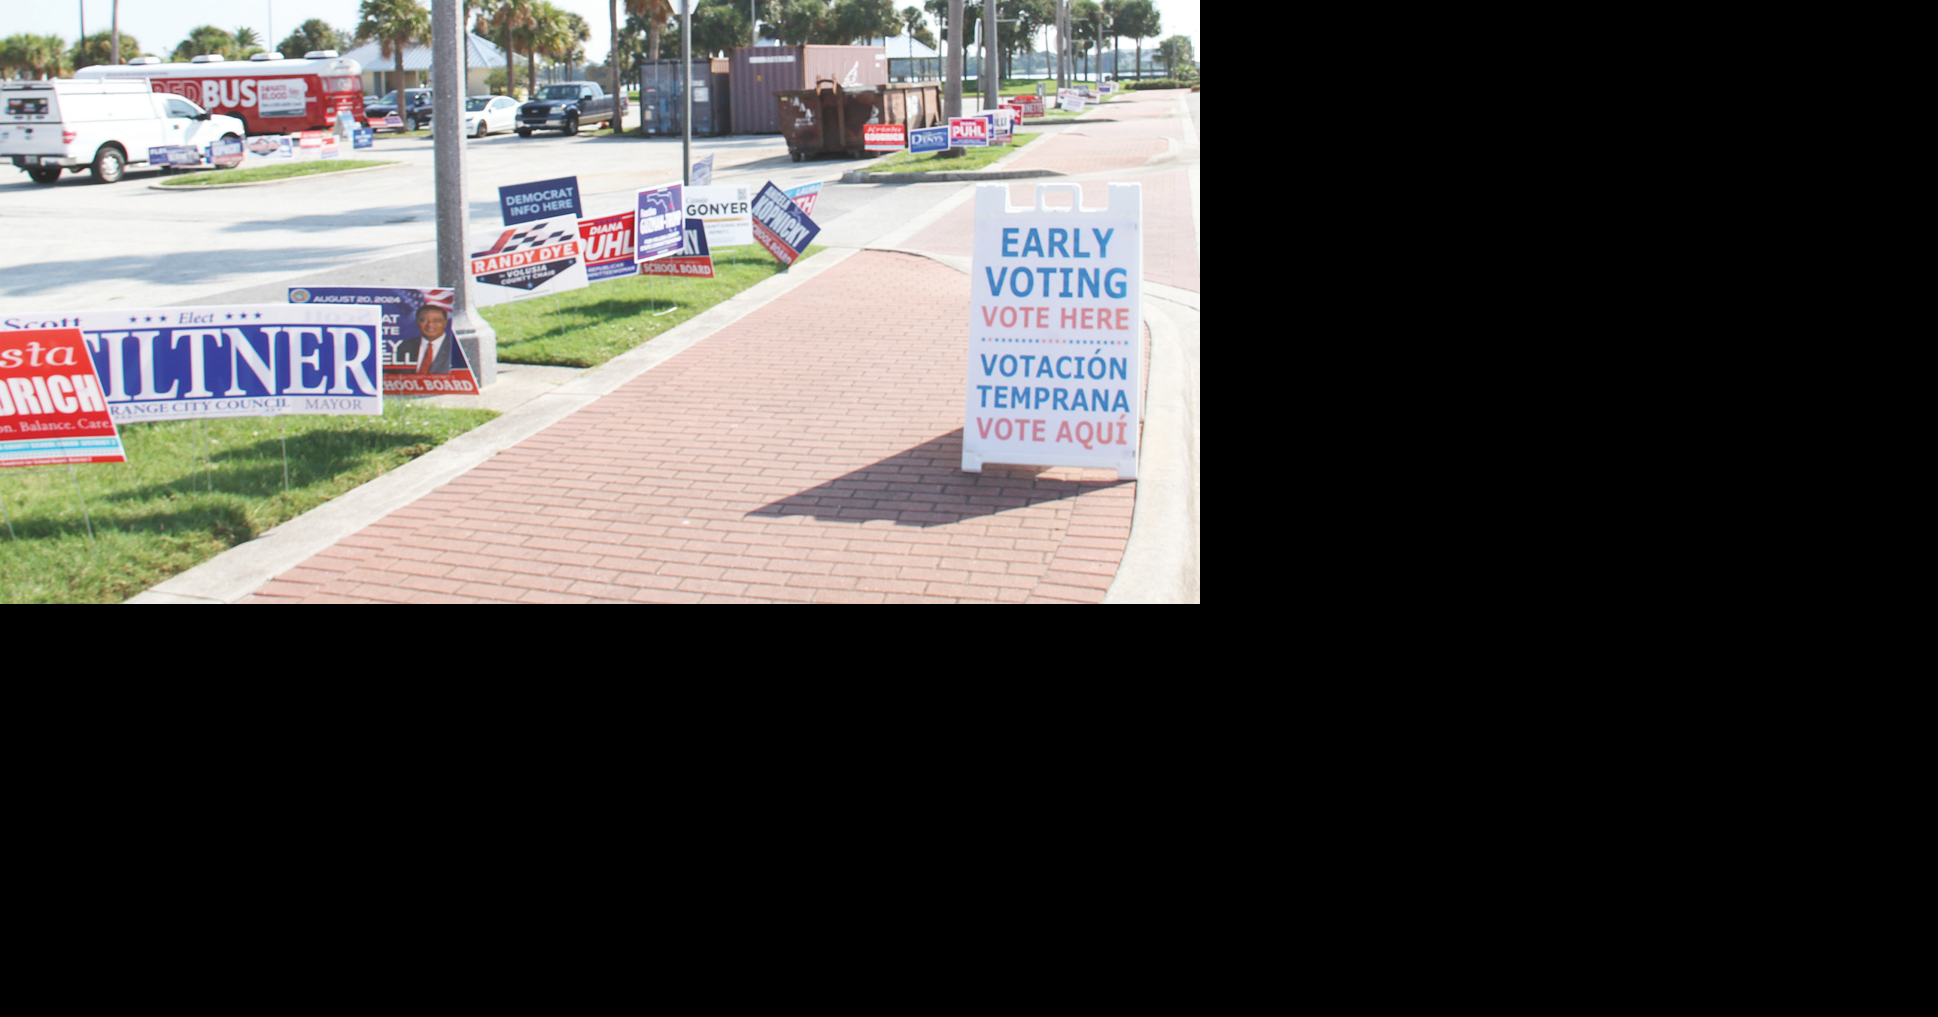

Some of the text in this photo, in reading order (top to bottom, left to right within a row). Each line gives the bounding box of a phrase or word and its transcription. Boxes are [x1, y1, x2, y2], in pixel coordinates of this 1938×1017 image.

[202, 79, 258, 108] BUS
[261, 92, 288, 101] BLOOD
[952, 125, 985, 137] PUHL
[505, 187, 574, 206] DEMOCRAT
[764, 186, 792, 211] ANGELA
[510, 198, 573, 217] INFO HERE
[686, 202, 748, 217] GONYER
[589, 221, 623, 236] DIANA
[752, 195, 810, 248] KOPNICKY
[1001, 228, 1114, 258] EARLY
[474, 243, 576, 273] RANDY DYE
[507, 264, 548, 279] VOLUSIA
[587, 262, 624, 273] REPUBLICAN
[644, 263, 711, 275] SCHOOL BOARD
[501, 275, 531, 286] COUNTY
[532, 269, 556, 280] CHAIR
[985, 266, 1127, 299] VOTING
[313, 295, 356, 303] AUGUST
[373, 295, 400, 304] 2024
[179, 312, 215, 324] Elect
[981, 306, 1130, 330] VOTE HERE
[980, 348, 1127, 380] VOTACIÓN
[423, 379, 474, 392] BOARD
[172, 400, 212, 413] CITY
[215, 397, 291, 411] COUNCIL
[305, 398, 363, 410] MAYOR
[976, 385, 1130, 413] TEMPRANA
[20, 418, 76, 432] Balance.
[976, 414, 1128, 450] VOTE AQUÍ
